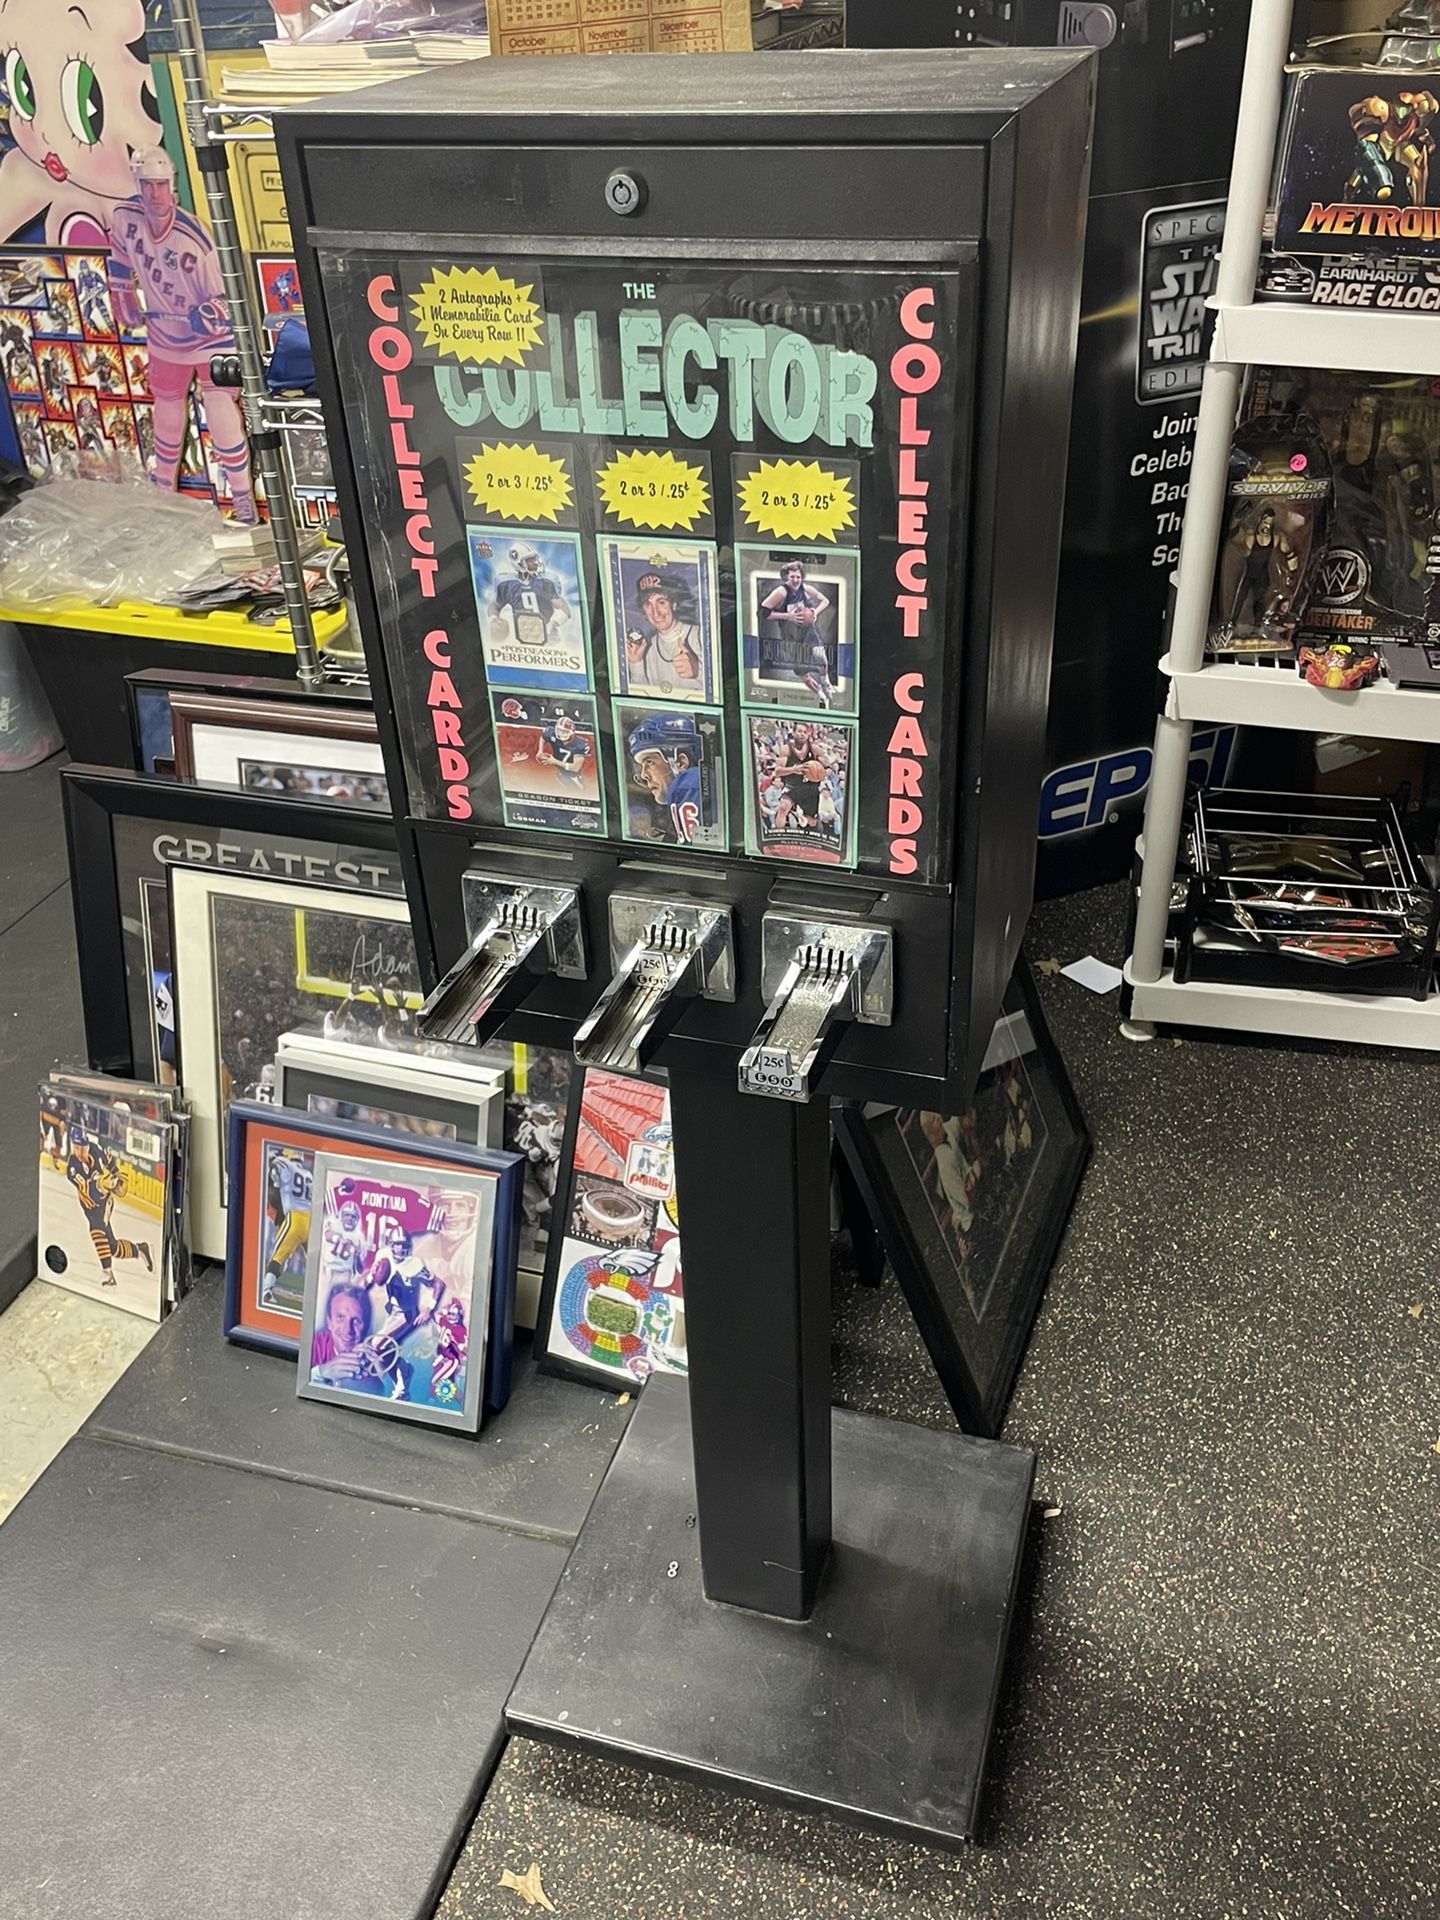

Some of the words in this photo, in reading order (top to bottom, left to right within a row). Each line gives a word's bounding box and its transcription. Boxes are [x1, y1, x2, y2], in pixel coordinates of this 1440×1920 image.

[588, 28, 627, 40] November
[660, 20, 699, 32] December
[509, 36, 547, 48] October
[1154, 215, 1218, 242] SPEC
[1298, 202, 1440, 241] METROI
[1180, 245, 1218, 261] TH
[1319, 267, 1418, 284] EARNHARDT
[438, 288, 447, 304] 2
[450, 288, 513, 310] Autographs
[622, 282, 657, 301] THE
[1311, 281, 1375, 306] RACE
[430, 305, 502, 323] Memorabilia
[504, 308, 533, 324] Card
[1150, 294, 1206, 337] WA
[452, 323, 484, 344] Every
[486, 325, 513, 341] Row
[889, 286, 943, 638] COLLECT
[1129, 444, 1193, 477] Celeb
[486, 474, 494, 488] 2
[497, 477, 512, 488] or
[514, 474, 522, 489] 3
[619, 480, 627, 496] 2
[631, 485, 645, 497] or
[648, 482, 656, 498] 3
[1231, 480, 1329, 496] SURVIVOR
[761, 490, 769, 506] 2
[773, 494, 787, 507] or
[792, 492, 800, 508] 3
[1150, 482, 1190, 505] Bac
[1287, 492, 1326, 501] SERIES
[1156, 511, 1181, 535] Th
[366, 274, 440, 599] COLLECT
[422, 629, 474, 820] CARDS
[1151, 544, 1180, 567] Sc
[490, 648, 581, 670] PERFORMERS
[504, 646, 566, 658] POSTSEASON
[886, 672, 929, 875] CARDS
[151, 833, 390, 889] GREATEST
[763, 1055, 784, 1069] 25¢
[360, 1190, 407, 1212] MONTANA
